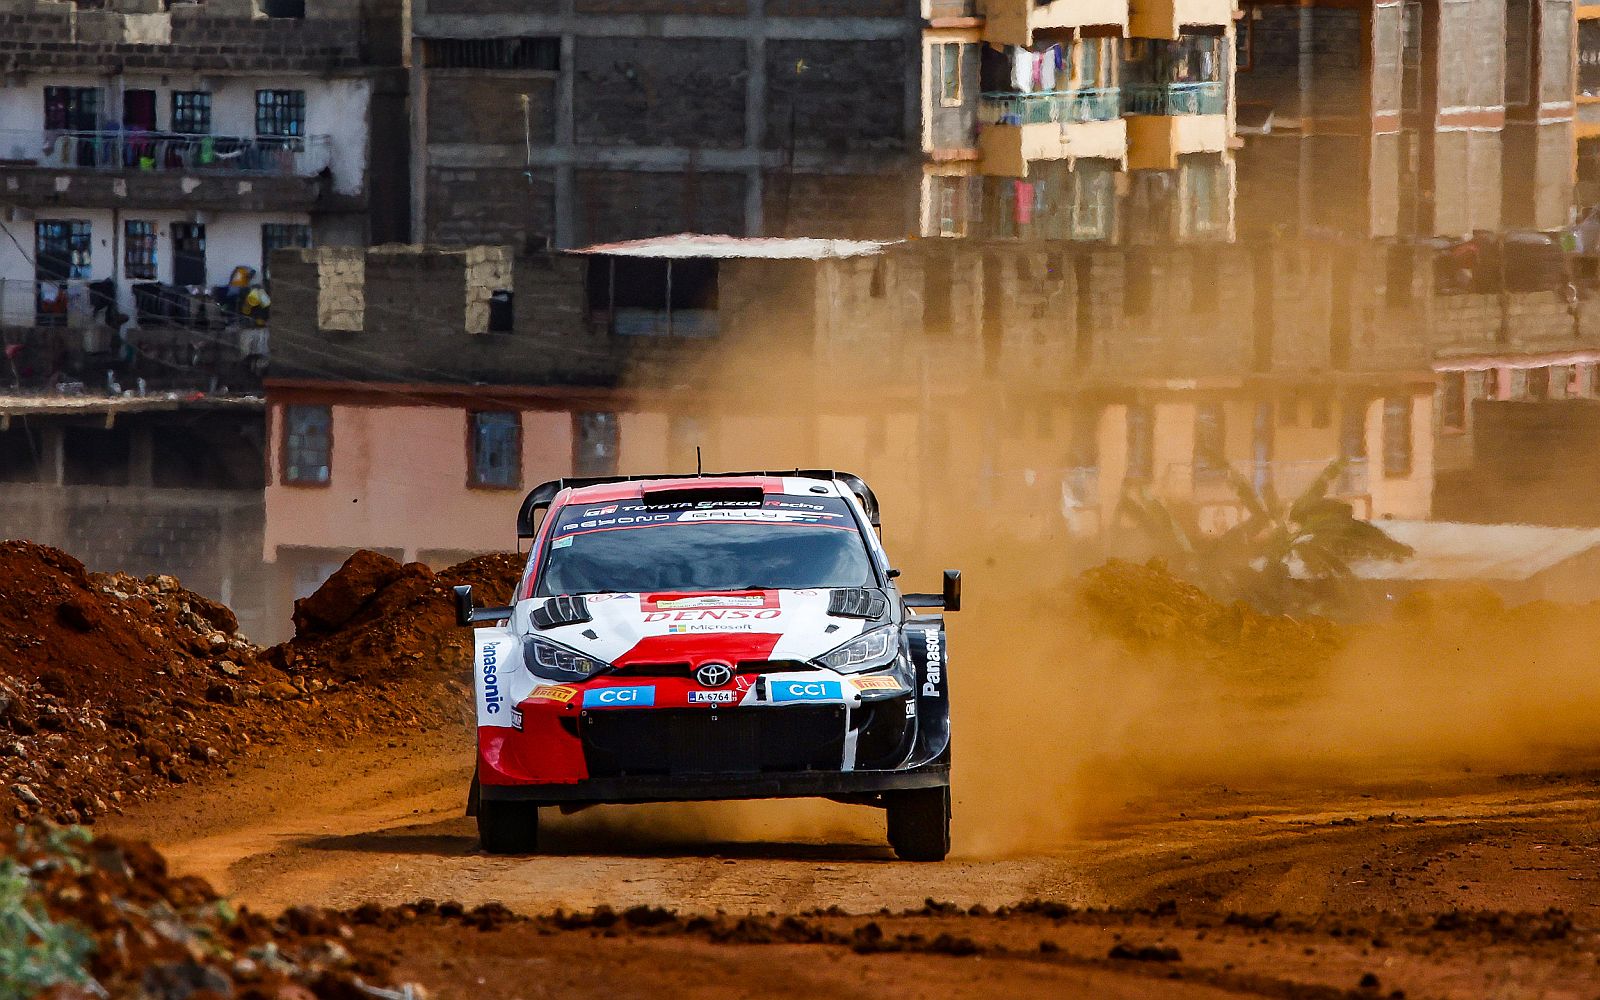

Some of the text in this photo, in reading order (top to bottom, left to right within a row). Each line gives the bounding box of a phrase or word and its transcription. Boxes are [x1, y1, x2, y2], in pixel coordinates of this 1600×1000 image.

[622, 500, 824, 511] TOYOTA GAZOO Racing
[643, 610, 781, 623] DENSO
[483, 641, 504, 714] Panasonic
[707, 693, 729, 701] 6764
